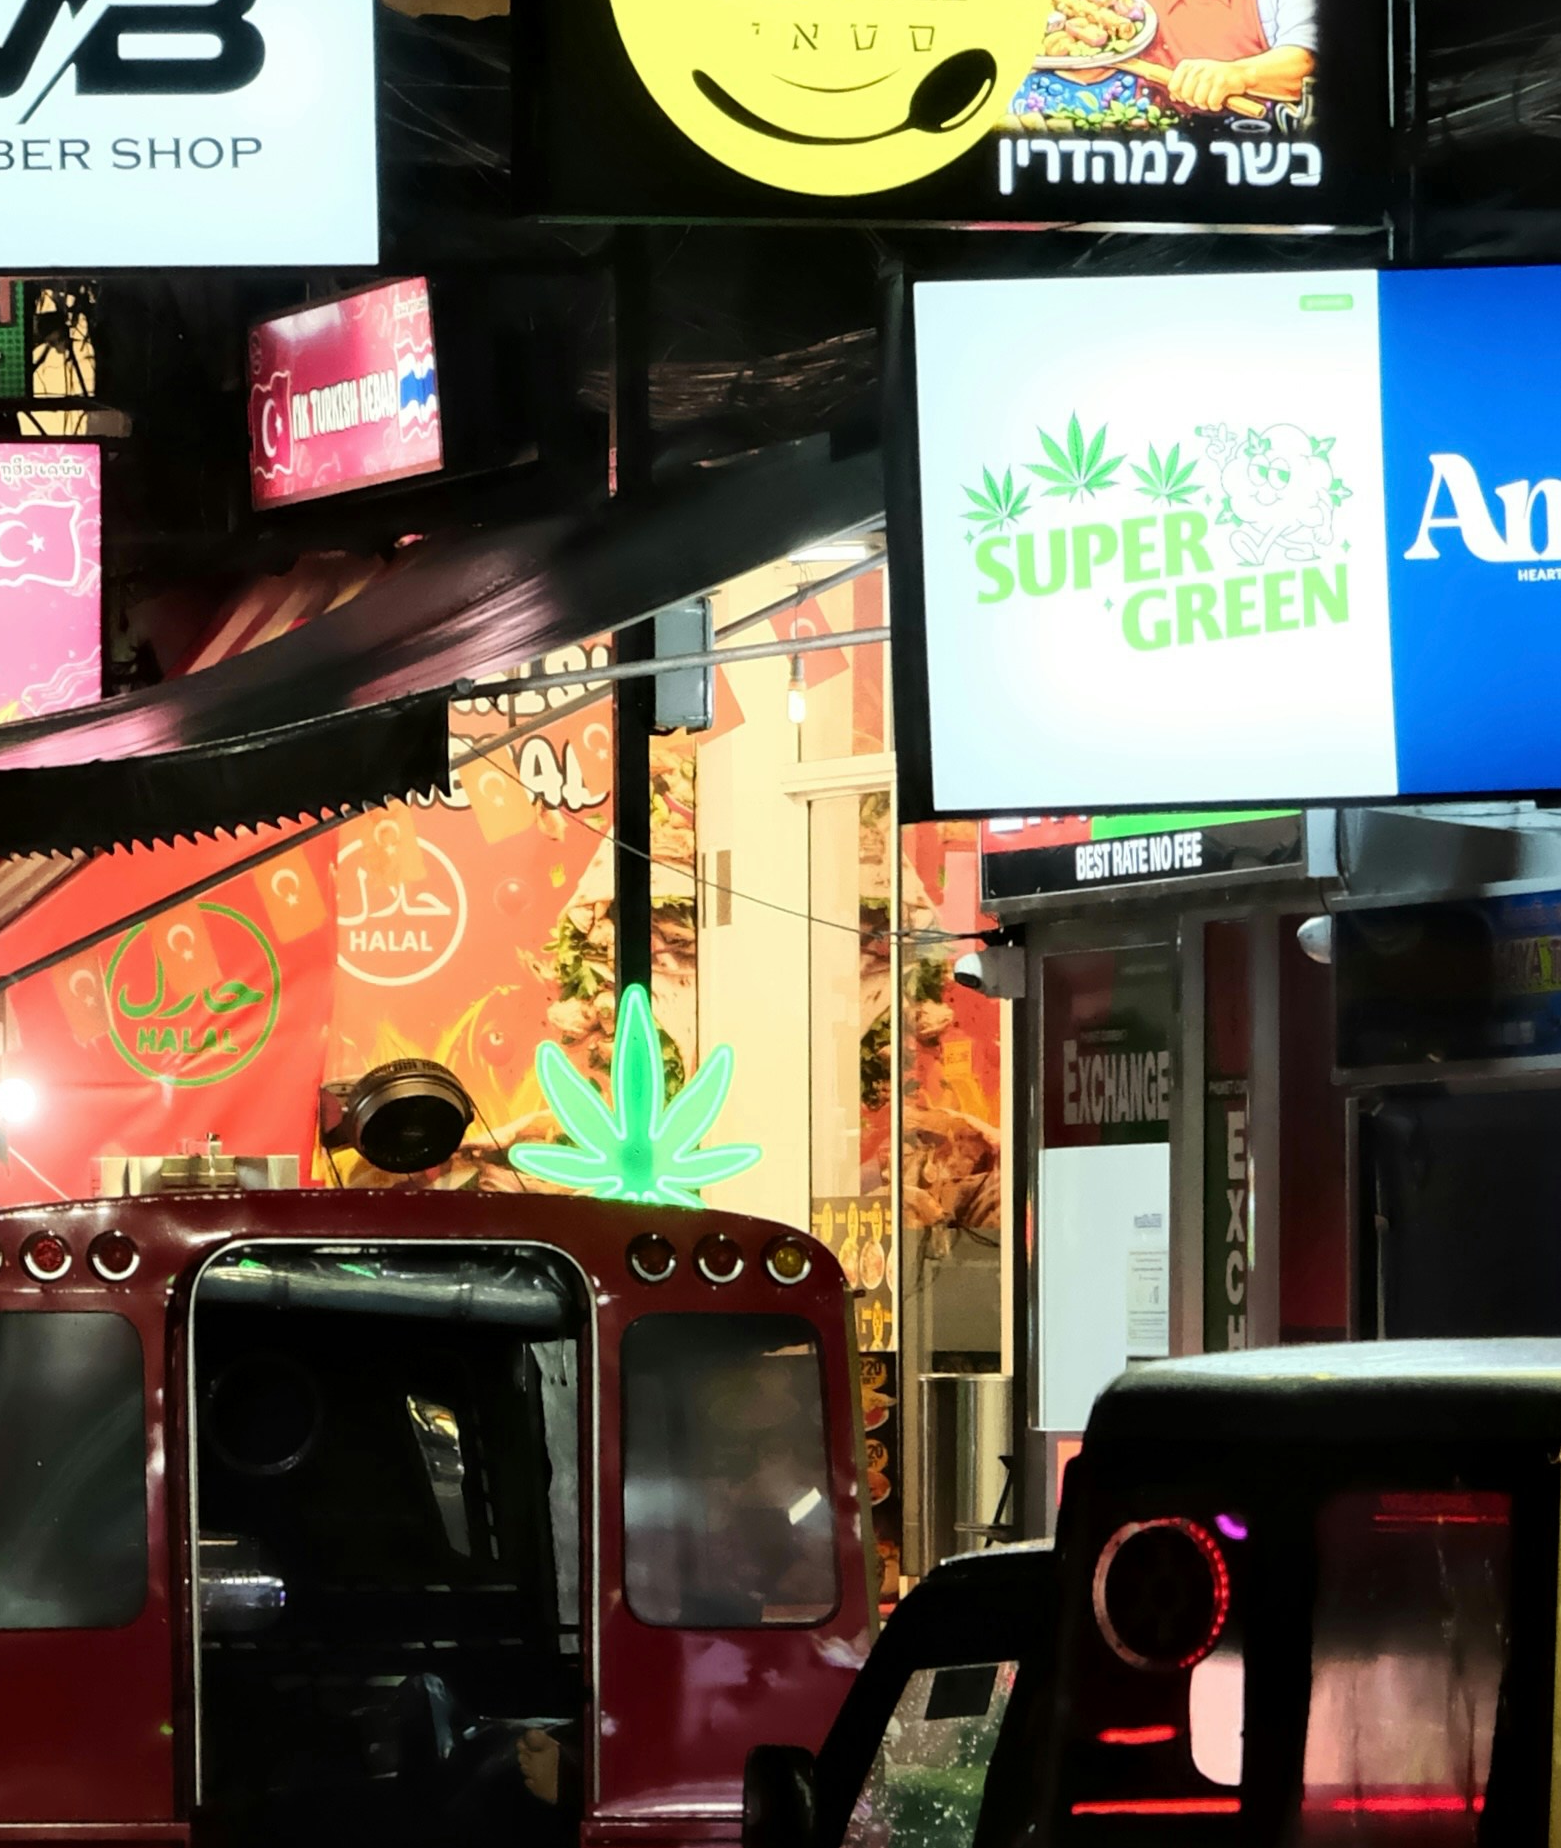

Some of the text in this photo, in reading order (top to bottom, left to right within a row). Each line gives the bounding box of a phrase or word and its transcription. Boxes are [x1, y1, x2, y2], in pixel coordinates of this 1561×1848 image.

[112, 137, 263, 170] SHOP
[998, 129, 1322, 195] כשר למהדרין
[310, 379, 359, 435] TURKISH
[974, 510, 1214, 605] SUPER
[1122, 563, 1350, 653] GREEN
[1075, 831, 1203, 882] BEST RATE NO FEE
[349, 930, 433, 952] HALAL
[137, 1026, 239, 1055] HALAL
[1062, 1039, 1170, 1127] EXCHANGE
